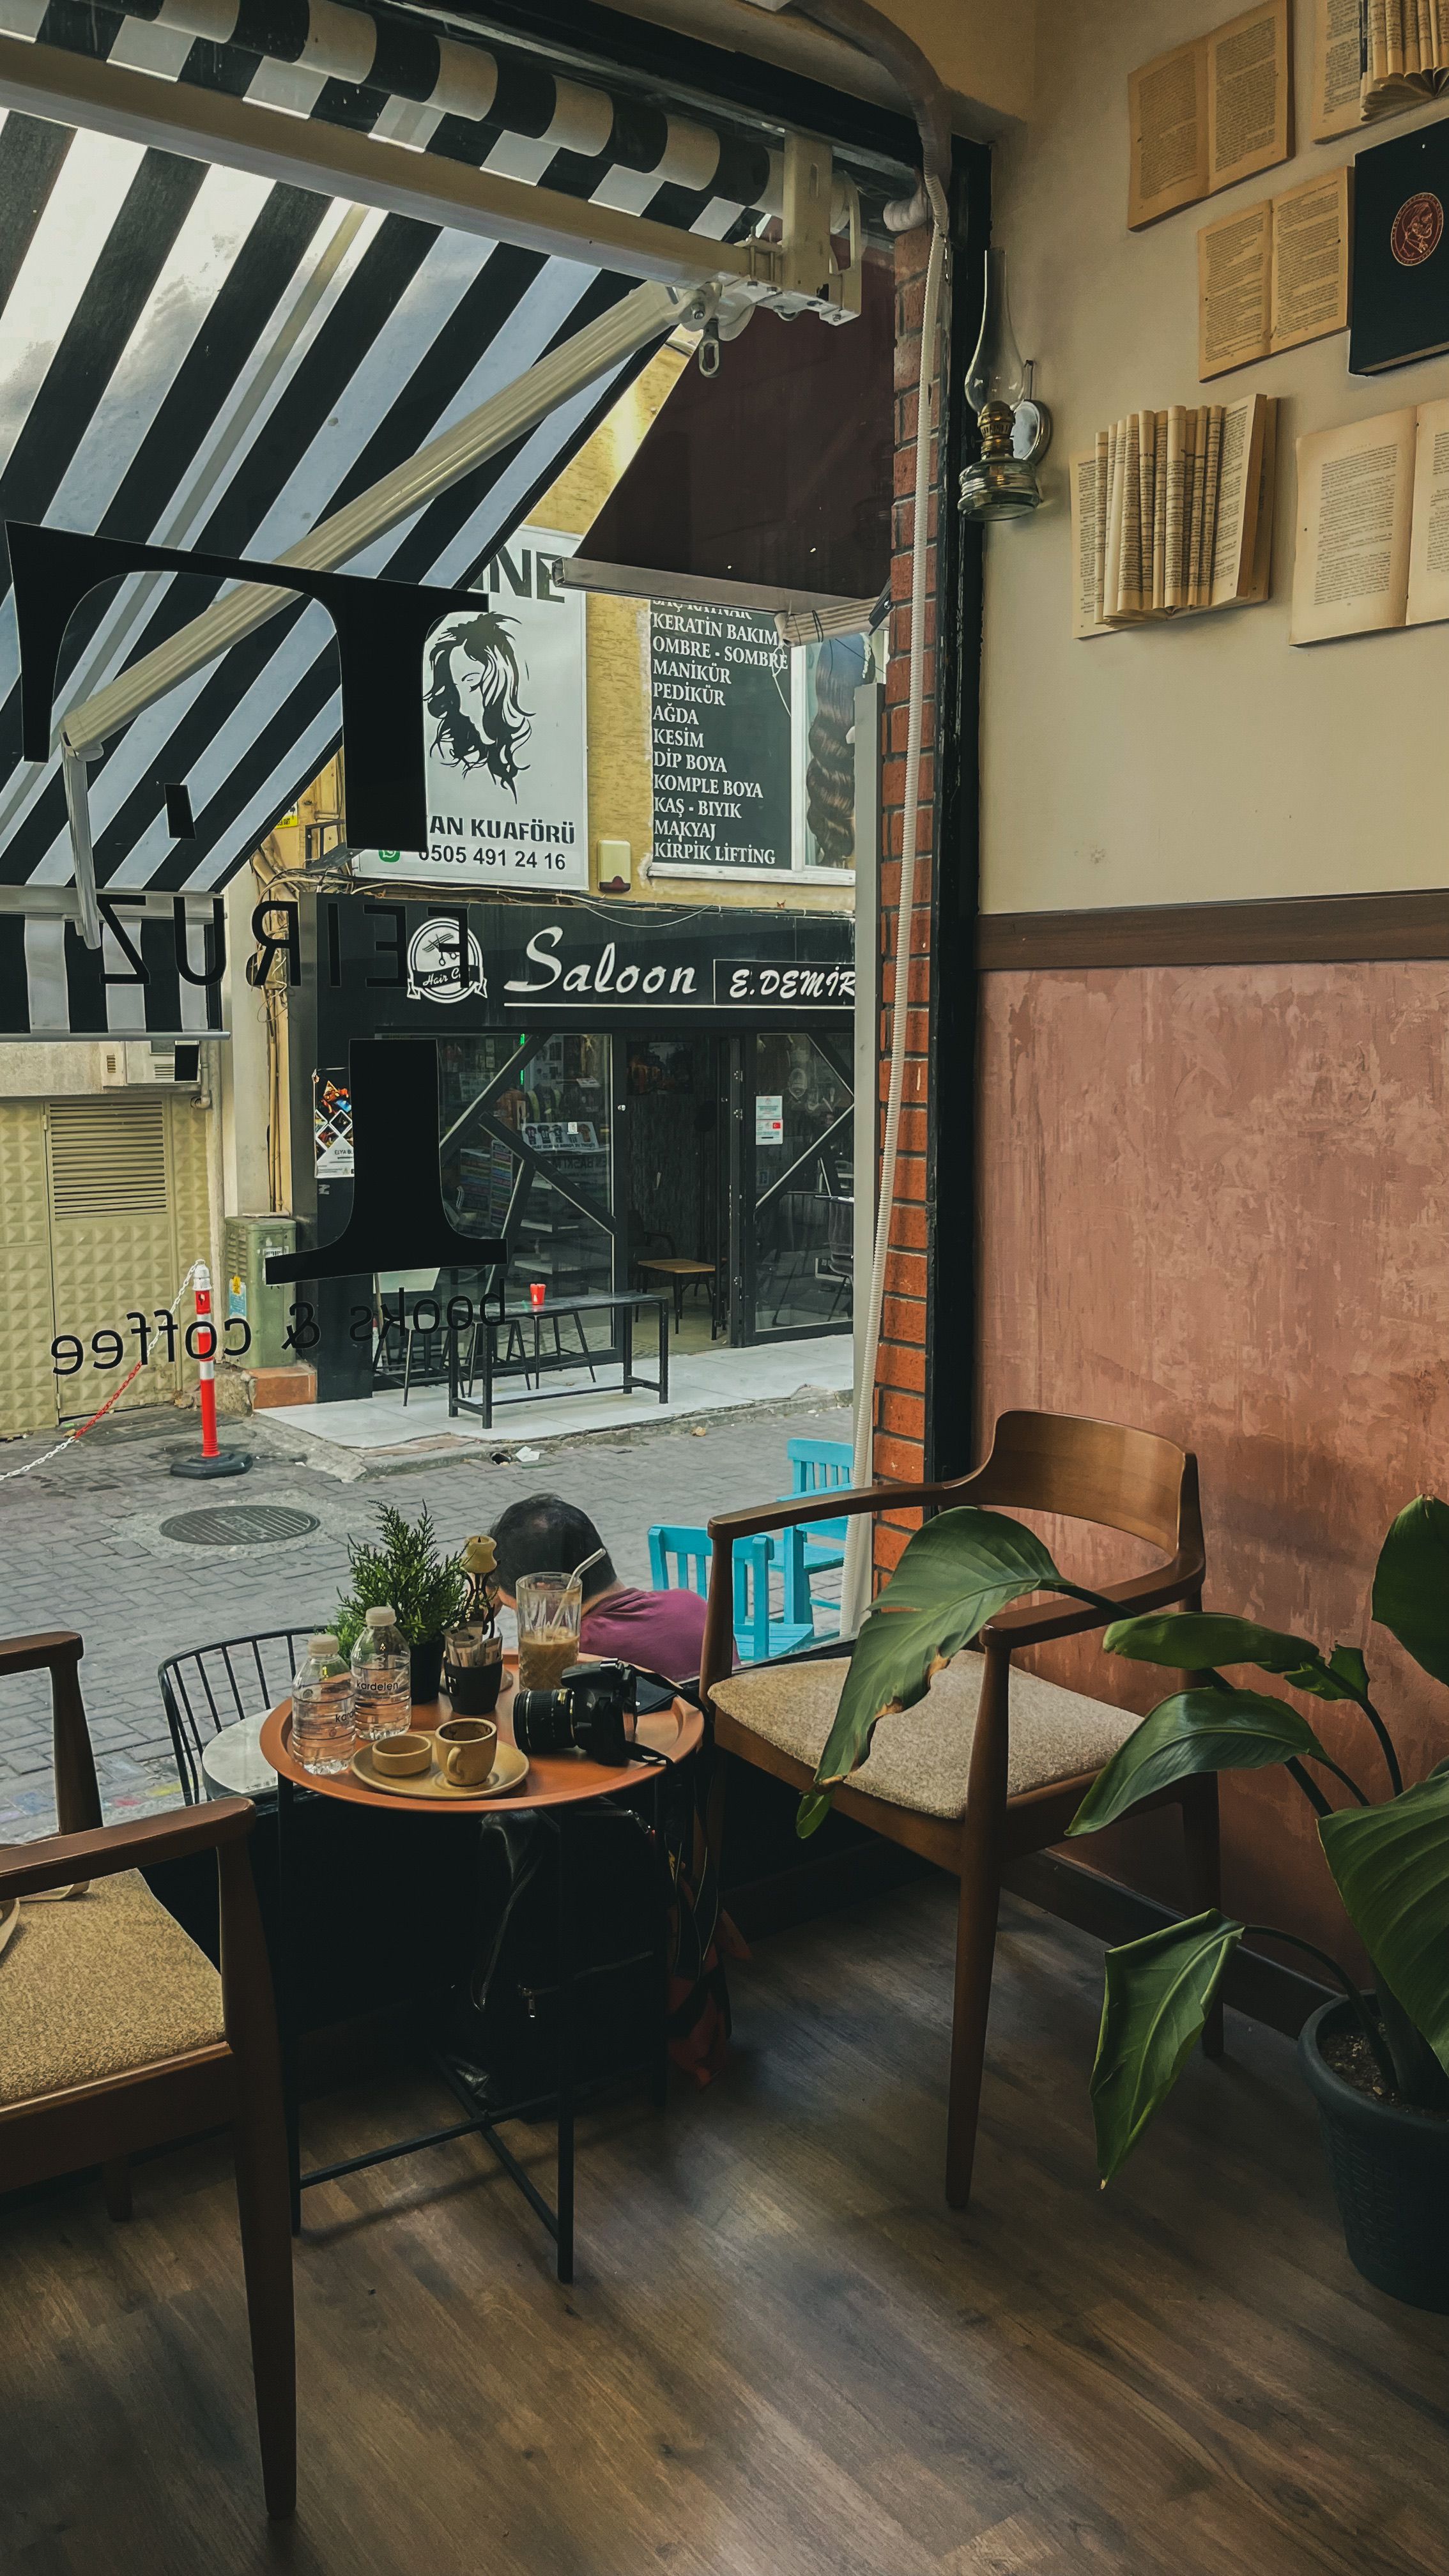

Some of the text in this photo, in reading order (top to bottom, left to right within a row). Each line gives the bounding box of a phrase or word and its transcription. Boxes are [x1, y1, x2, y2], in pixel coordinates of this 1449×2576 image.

[652, 611, 778, 646] KERATİN BAKIM
[652, 636, 711, 659] OMBRE
[724, 646, 788, 670] SOMBRE
[653, 659, 732, 684] MANİKÜR
[653, 681, 726, 706] PEDİKÜR
[652, 702, 700, 725] AĞDA
[653, 727, 704, 748] KESİM
[654, 747, 728, 773] DİP BOYA
[654, 774, 763, 799] KOMPLE BOYA
[654, 797, 684, 818] KAŞ
[698, 800, 742, 818] BIYIK
[471, 818, 575, 845] KUAFÖRÜ
[654, 819, 716, 842] MAKYAJ
[418, 845, 566, 870] 0505 491 24 16
[654, 838, 776, 864] KİRPİK LİFTİNG
[503, 926, 855, 999] Saloon E.DEMİR
[422, 973, 448, 986] Hair
[356, 1681, 399, 1692] kardelen
